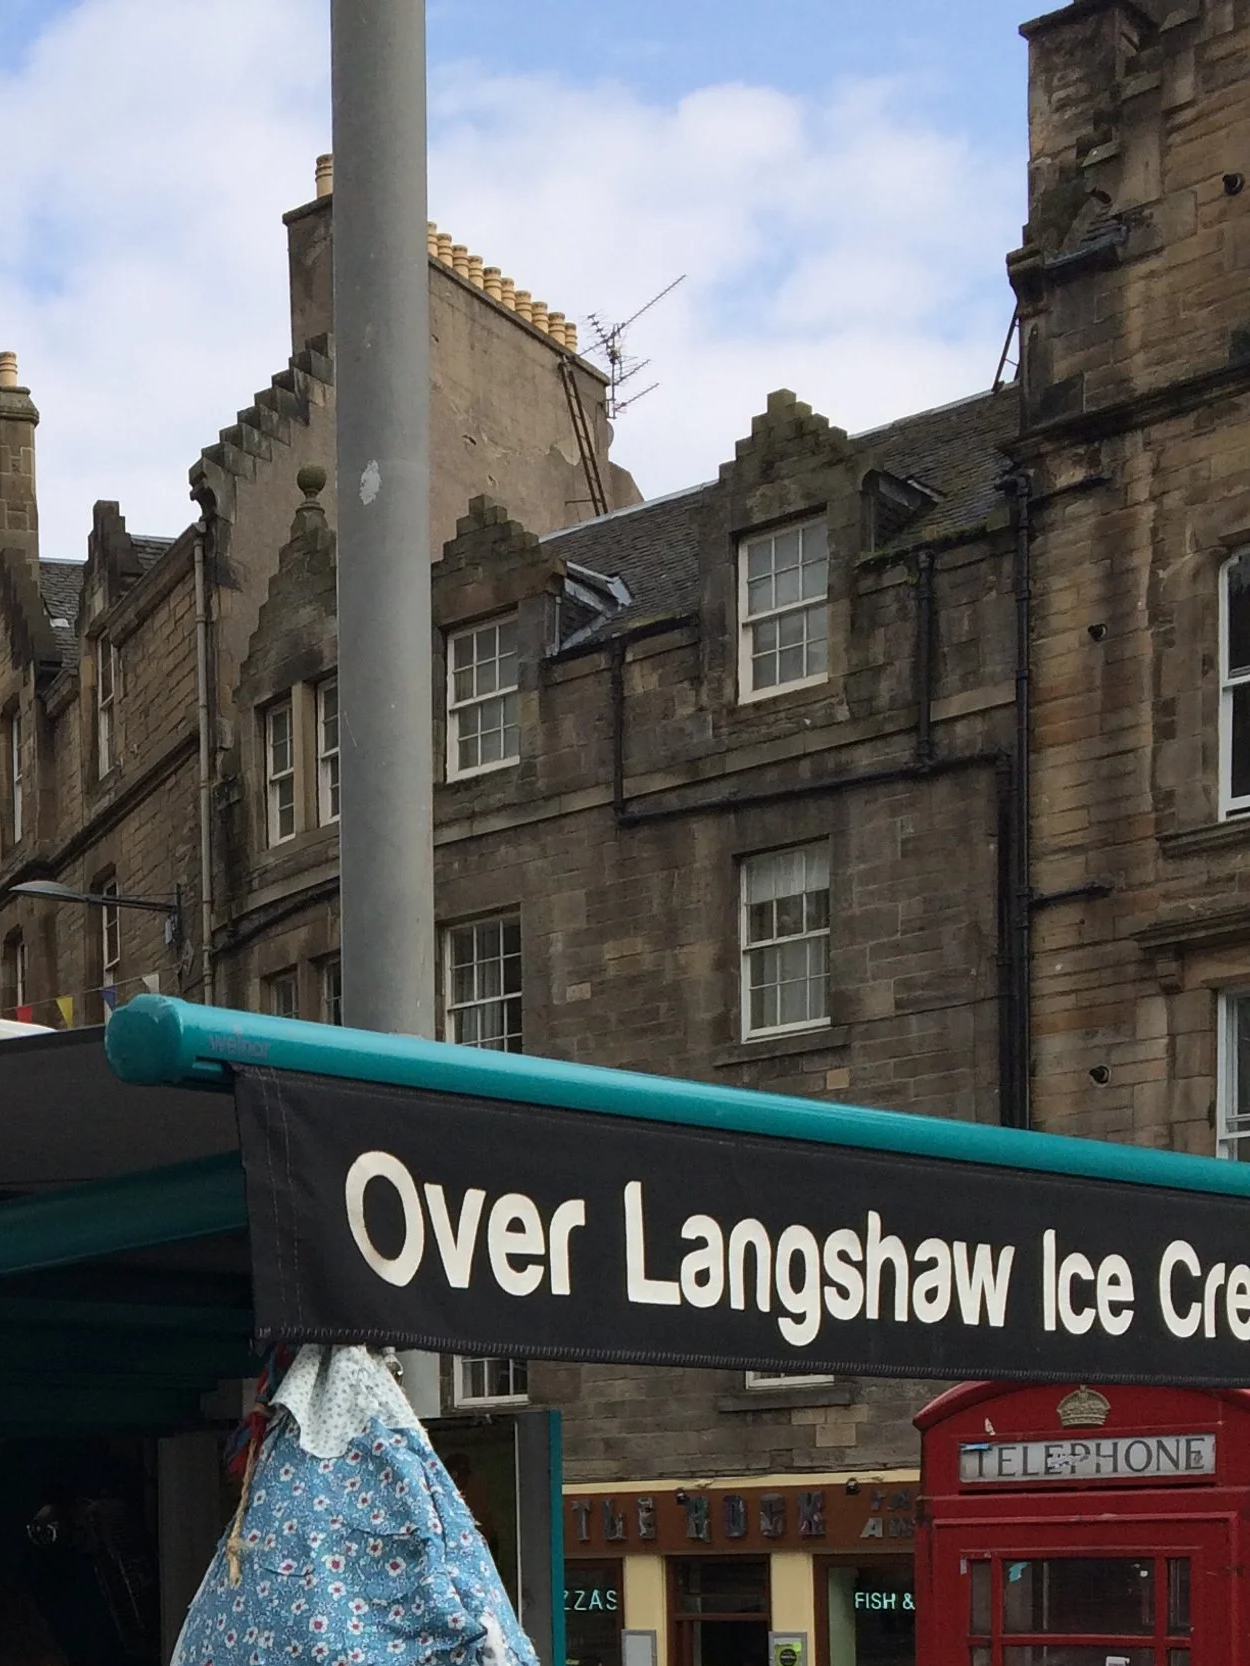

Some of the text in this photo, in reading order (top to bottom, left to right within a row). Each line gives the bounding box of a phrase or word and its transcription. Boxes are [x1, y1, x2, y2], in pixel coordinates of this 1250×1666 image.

[344, 1149, 586, 1297] Over
[622, 1179, 1016, 1347] Langshaw
[1043, 1228, 1135, 1336] Ice
[974, 1437, 1206, 1478] TELEPHONE
[854, 1591, 916, 1610] FISH &
